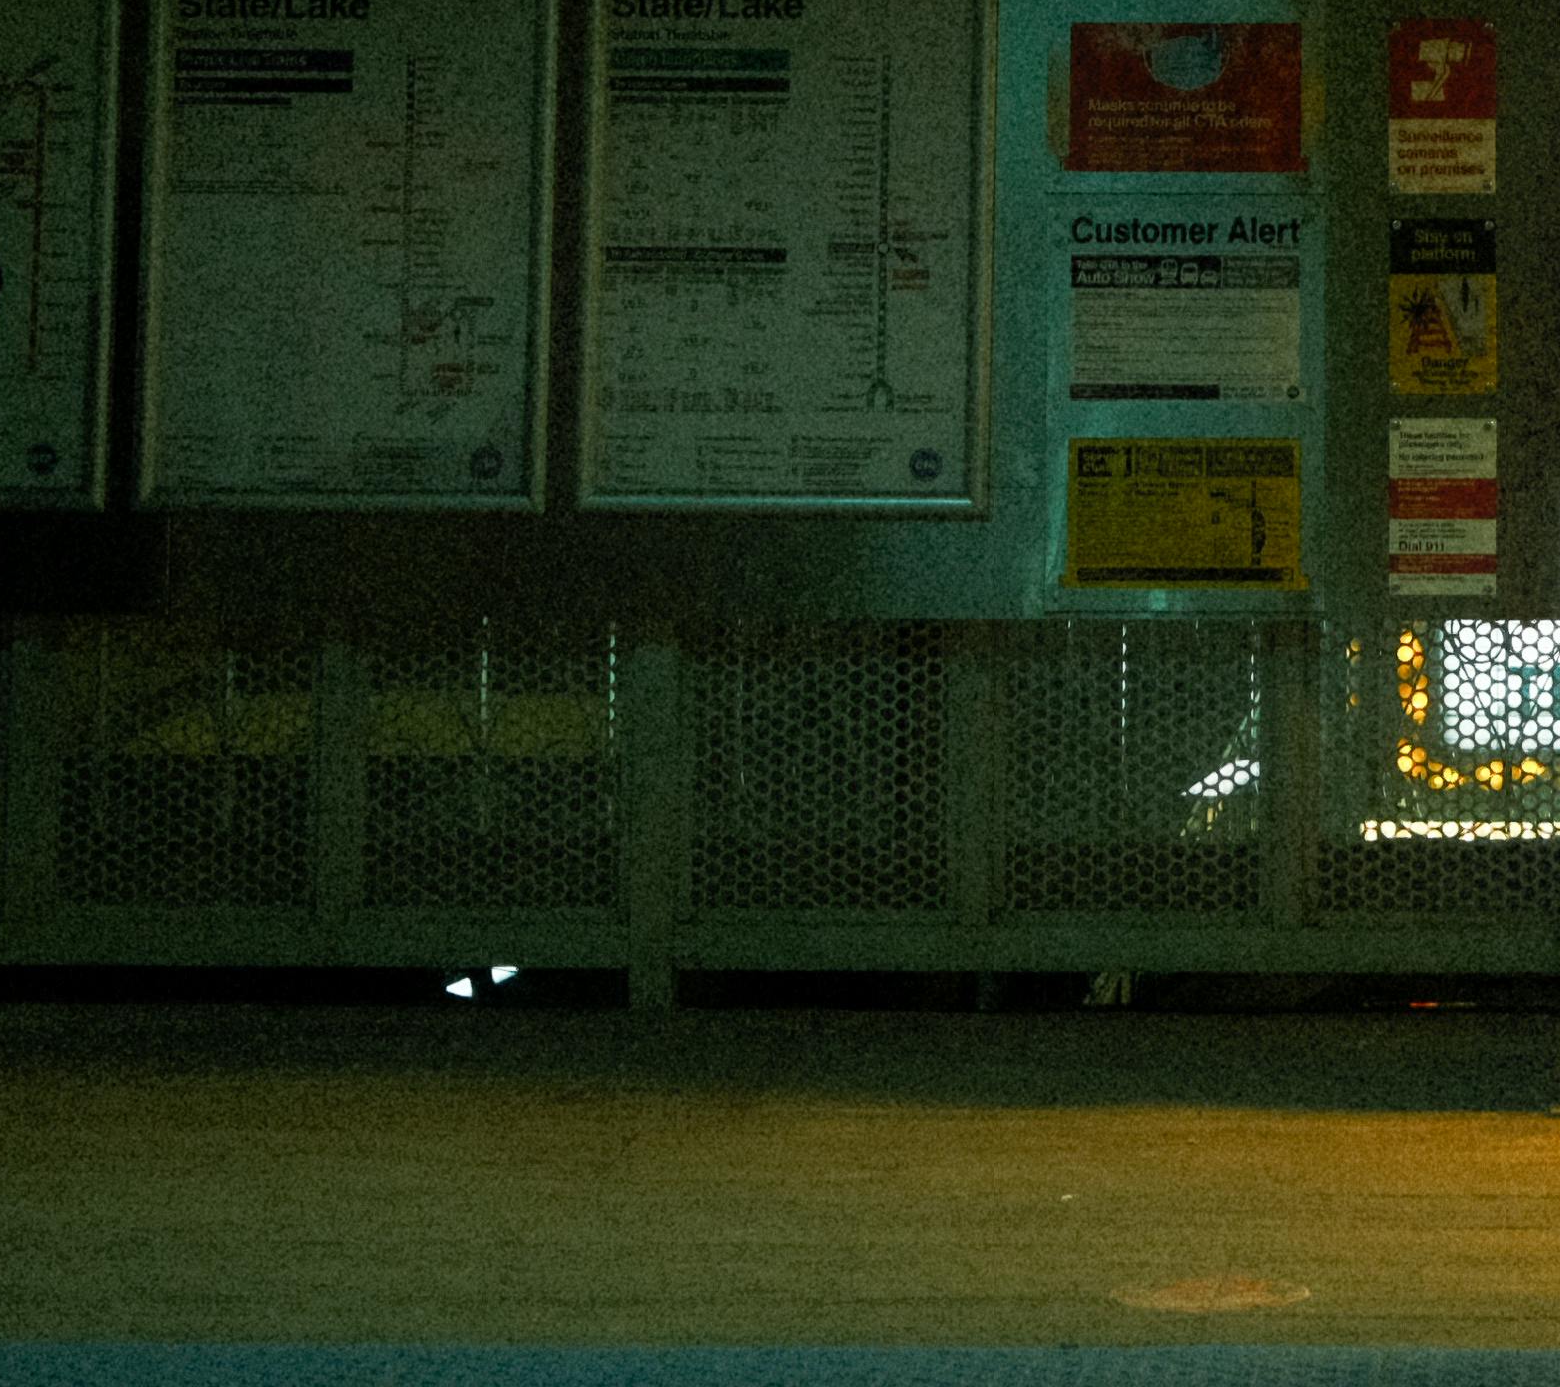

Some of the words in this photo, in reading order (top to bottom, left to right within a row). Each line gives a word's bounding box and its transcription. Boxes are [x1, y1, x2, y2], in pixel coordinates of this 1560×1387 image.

[1397, 129, 1483, 143] Surveillance
[1397, 148, 1458, 159] cameras
[1397, 165, 1416, 175] on
[1420, 163, 1485, 176] premises
[1069, 216, 1219, 245] Customer
[1227, 215, 1301, 245] Alert
[1076, 271, 1111, 285] Auto
[1114, 270, 1156, 285] Show
[1398, 540, 1422, 552] Dial
[1426, 540, 1445, 552] 911
